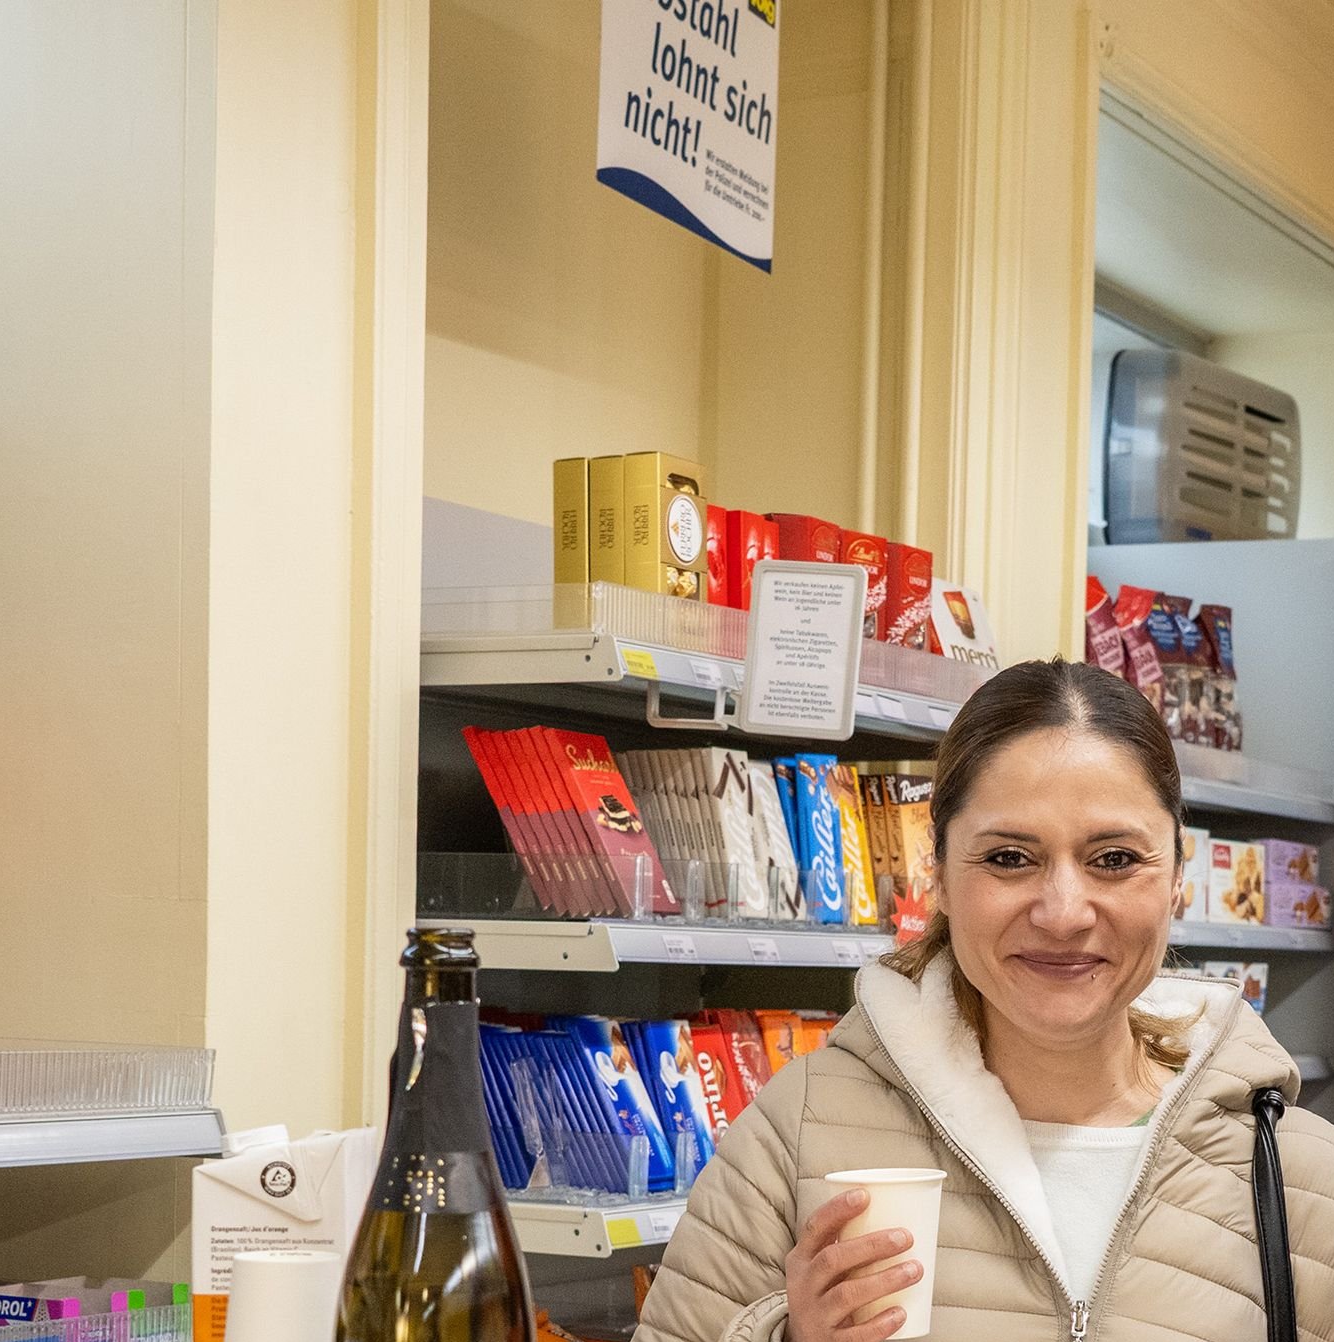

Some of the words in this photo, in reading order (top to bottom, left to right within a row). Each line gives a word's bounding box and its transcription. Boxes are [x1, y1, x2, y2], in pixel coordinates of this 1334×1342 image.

[623, 88, 702, 168] nicht!
[651, 21, 720, 112] lohnt
[723, 80, 772, 145] sich
[811, 786, 843, 912] Cailler
